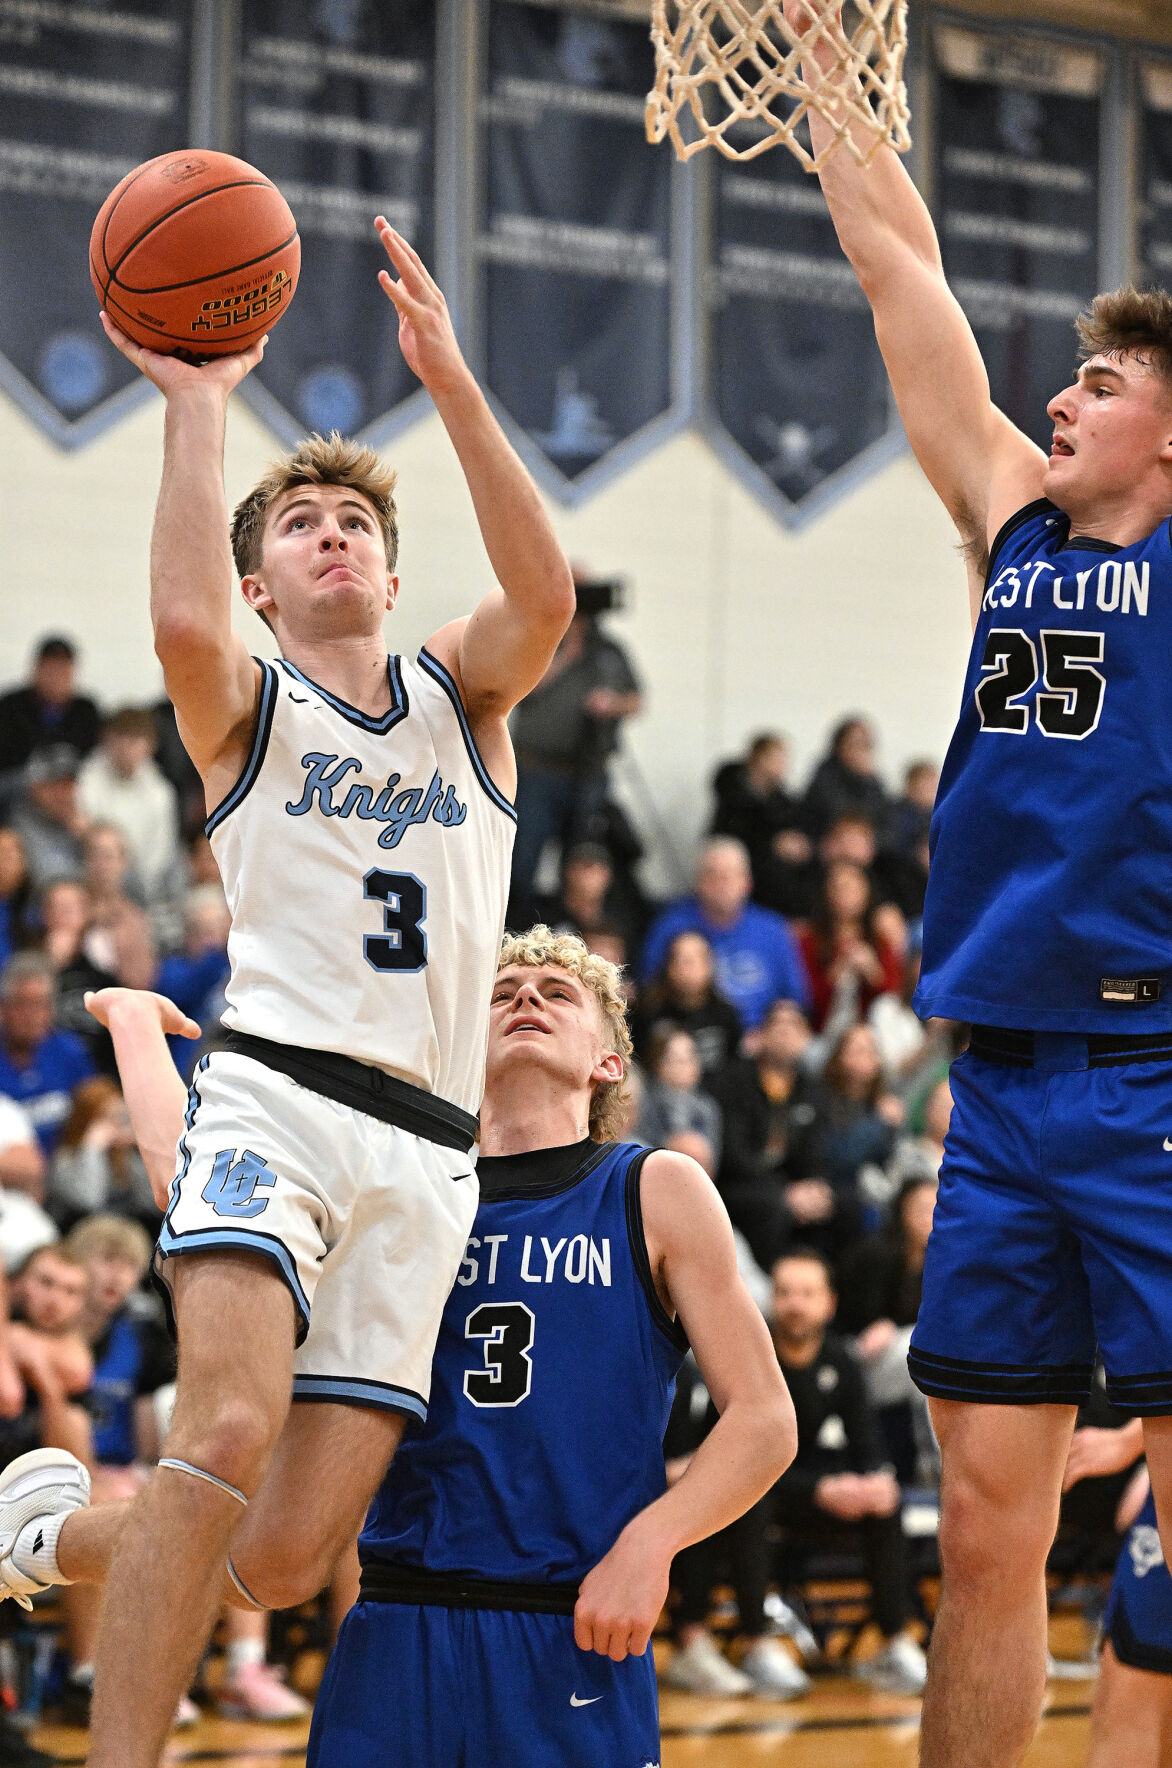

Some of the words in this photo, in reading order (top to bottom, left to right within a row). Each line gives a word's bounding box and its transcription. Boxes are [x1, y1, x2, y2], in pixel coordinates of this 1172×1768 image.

[191, 277, 292, 332] LEGACY
[201, 283, 268, 312] 1000
[982, 560, 1057, 613] EST
[1053, 559, 1150, 617] LYON
[974, 628, 1107, 741] 25
[285, 751, 467, 850] Knighs
[362, 865, 429, 974] 3
[1143, 985, 1152, 996] L
[519, 1233, 612, 1287] LYON
[462, 1301, 536, 1408] 3
